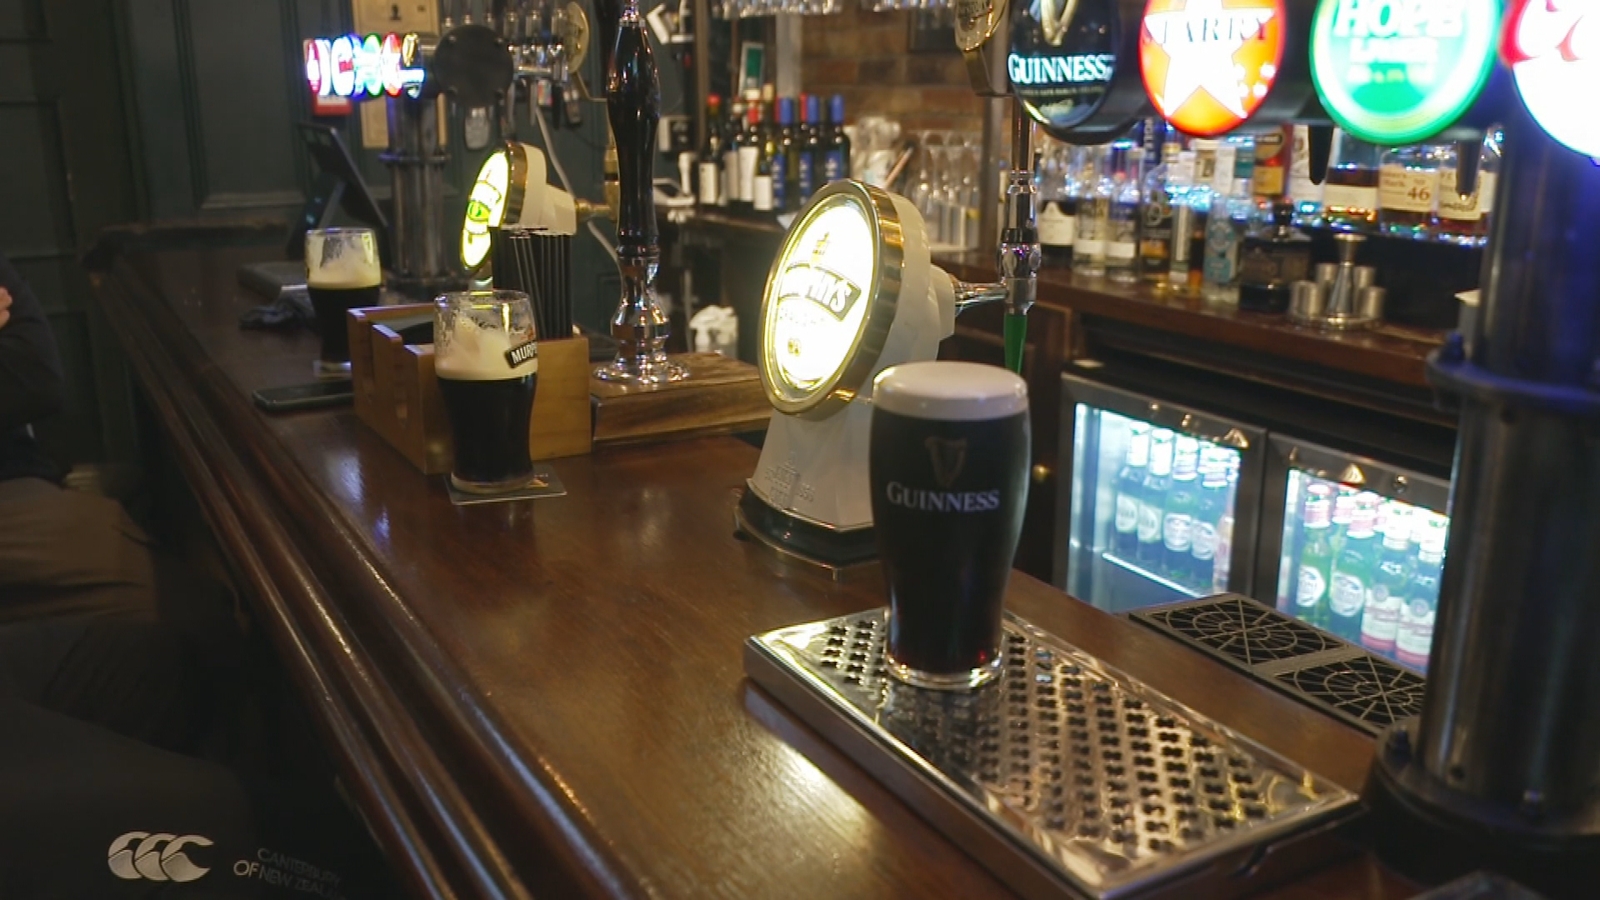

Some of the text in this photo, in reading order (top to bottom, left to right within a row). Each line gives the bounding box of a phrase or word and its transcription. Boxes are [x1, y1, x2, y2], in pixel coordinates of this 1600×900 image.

[1007, 53, 1113, 84] GUINNESS
[1407, 187, 1430, 201] 46
[886, 481, 1000, 512] GUINNESS
[233, 859, 260, 878] OF
